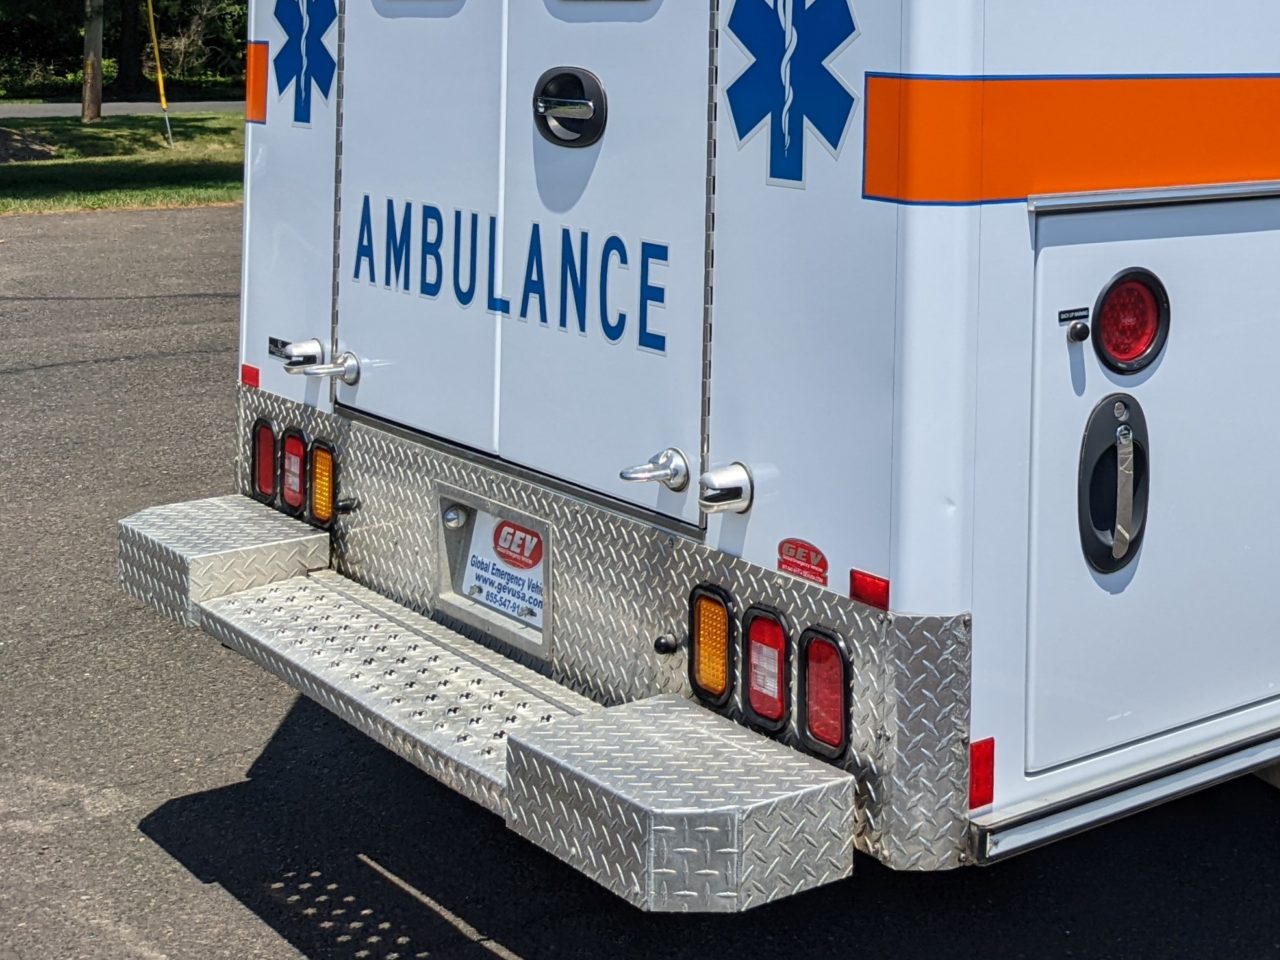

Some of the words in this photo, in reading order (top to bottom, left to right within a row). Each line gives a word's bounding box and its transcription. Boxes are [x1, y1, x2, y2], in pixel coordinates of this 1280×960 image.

[353, 195, 669, 352] AMBULANCE
[498, 526, 538, 557] GEV
[783, 543, 822, 566] GEV
[470, 554, 491, 574] Global
[490, 563, 526, 590] Emergency
